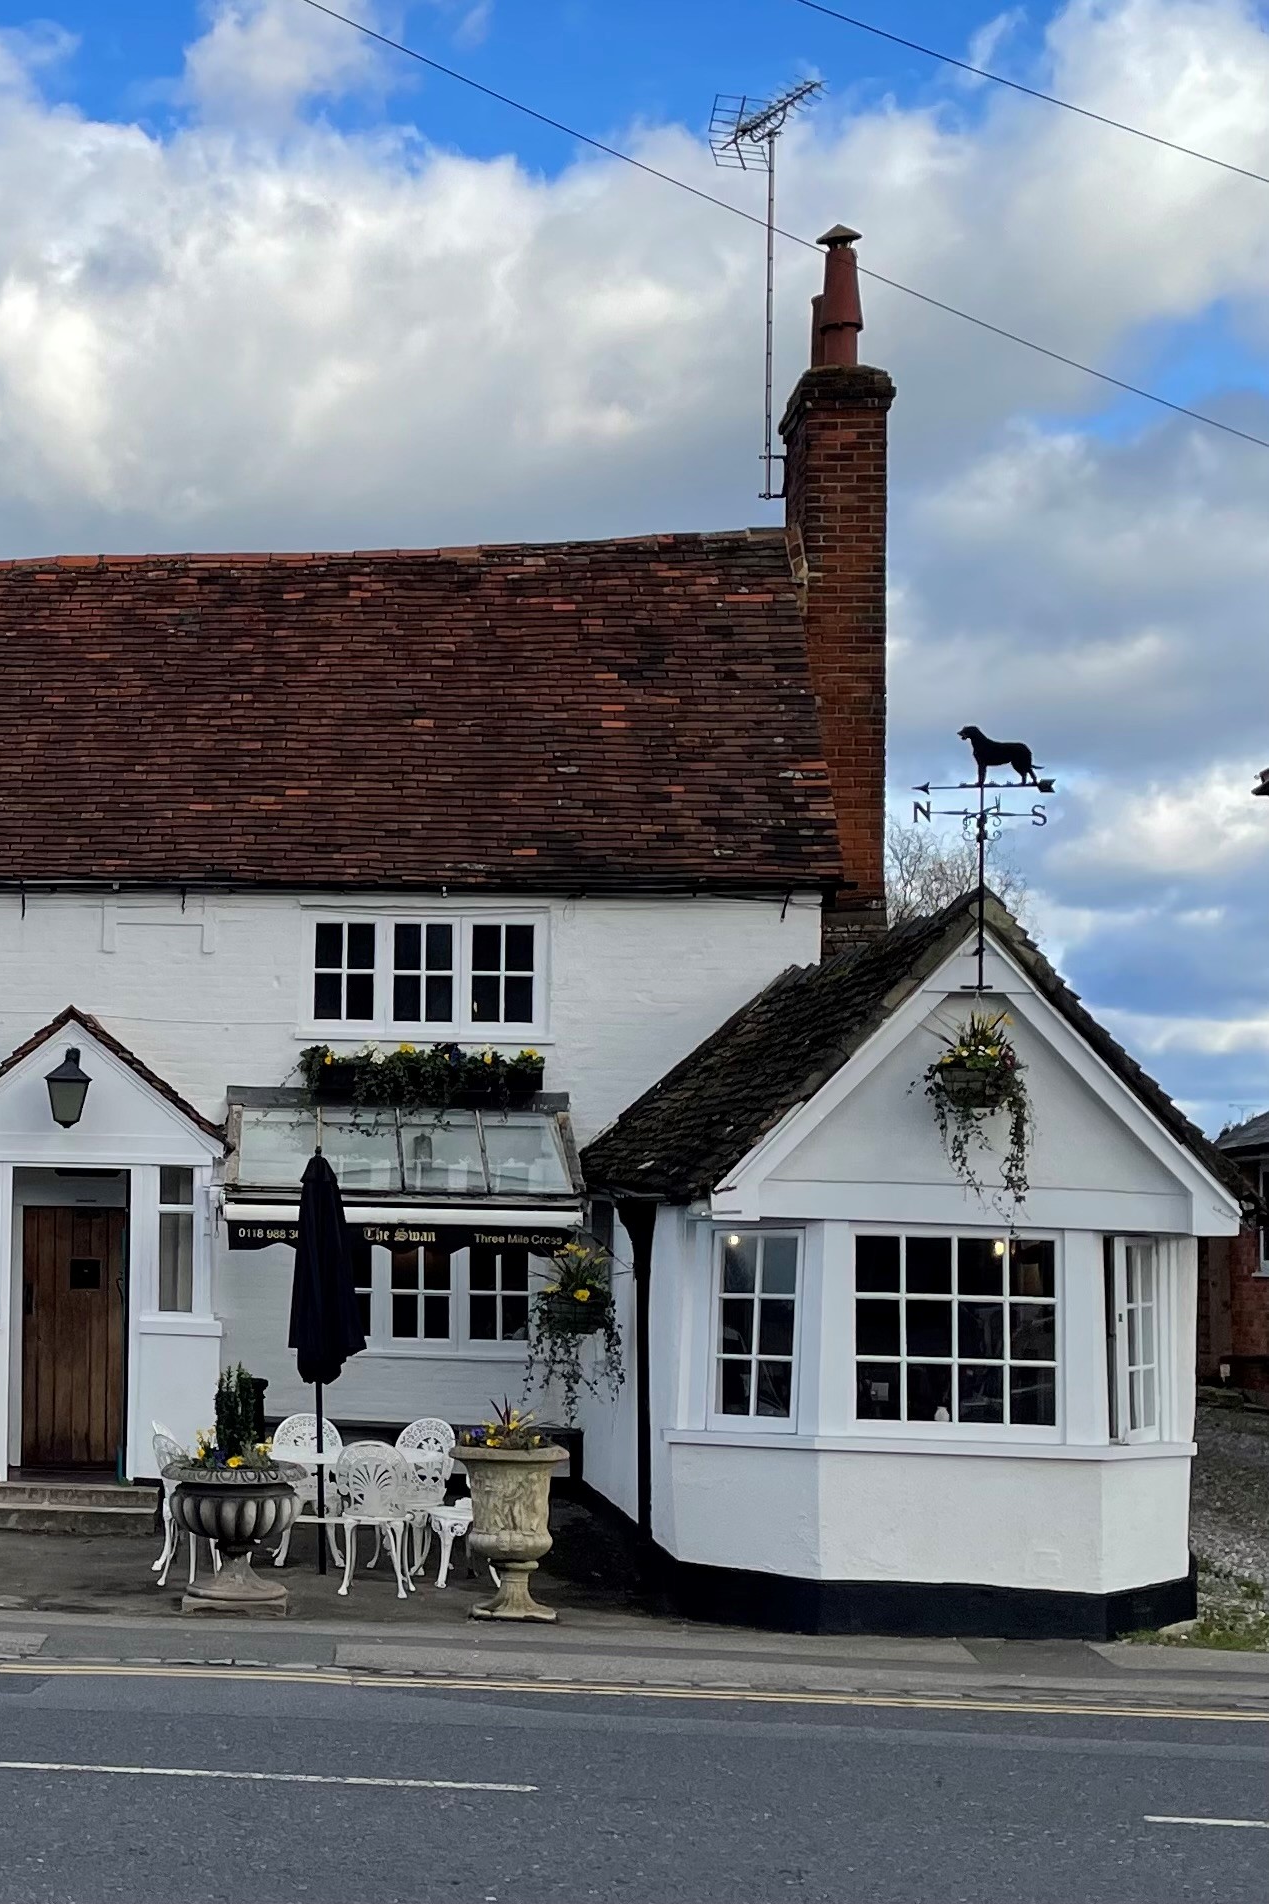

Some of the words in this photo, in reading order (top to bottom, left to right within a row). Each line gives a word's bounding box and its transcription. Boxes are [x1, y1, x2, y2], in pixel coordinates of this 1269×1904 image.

[913, 801, 931, 823] N
[1032, 804, 1048, 826] S
[238, 1227, 265, 1239] 0118
[266, 1228, 287, 1240] 988
[362, 1226, 390, 1243] The
[393, 1227, 436, 1243] Swan
[474, 1232, 506, 1245] Three
[507, 1233, 530, 1245] Mile
[531, 1234, 563, 1246] Cross
